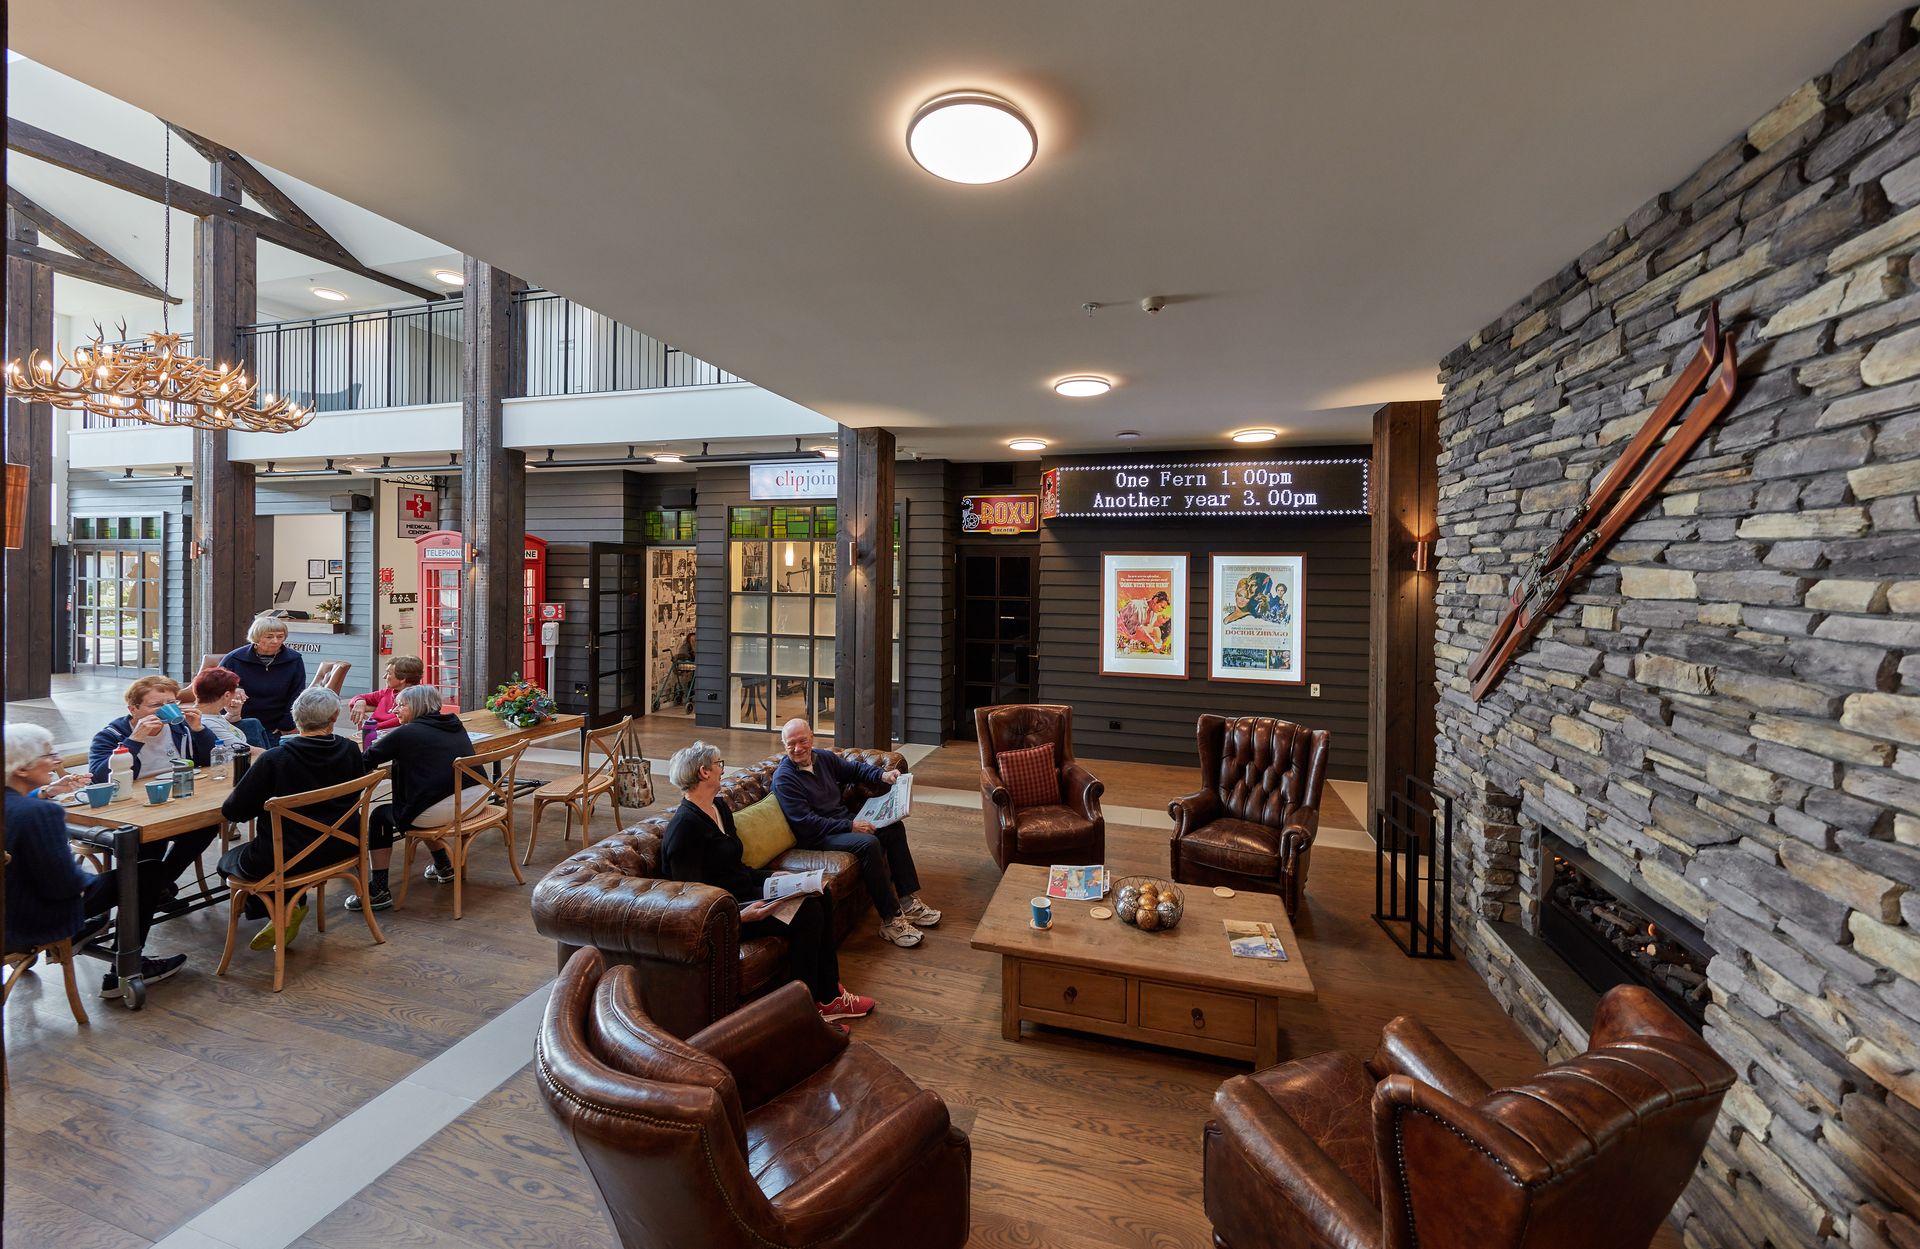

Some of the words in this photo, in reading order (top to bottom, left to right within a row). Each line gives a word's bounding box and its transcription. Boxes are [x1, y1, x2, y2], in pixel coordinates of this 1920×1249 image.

[775, 469, 836, 491] clipjoin
[1116, 472, 1149, 487] One
[1160, 471, 1207, 487] Fern
[1221, 469, 1292, 486] 1.00pm
[1093, 492, 1172, 508] Another
[1184, 494, 1231, 508] year
[1243, 489, 1317, 507] 3.00pm
[981, 501, 1035, 524] ROXY
[426, 549, 461, 557] TELEPHON
[285, 642, 321, 653] CEPTION
